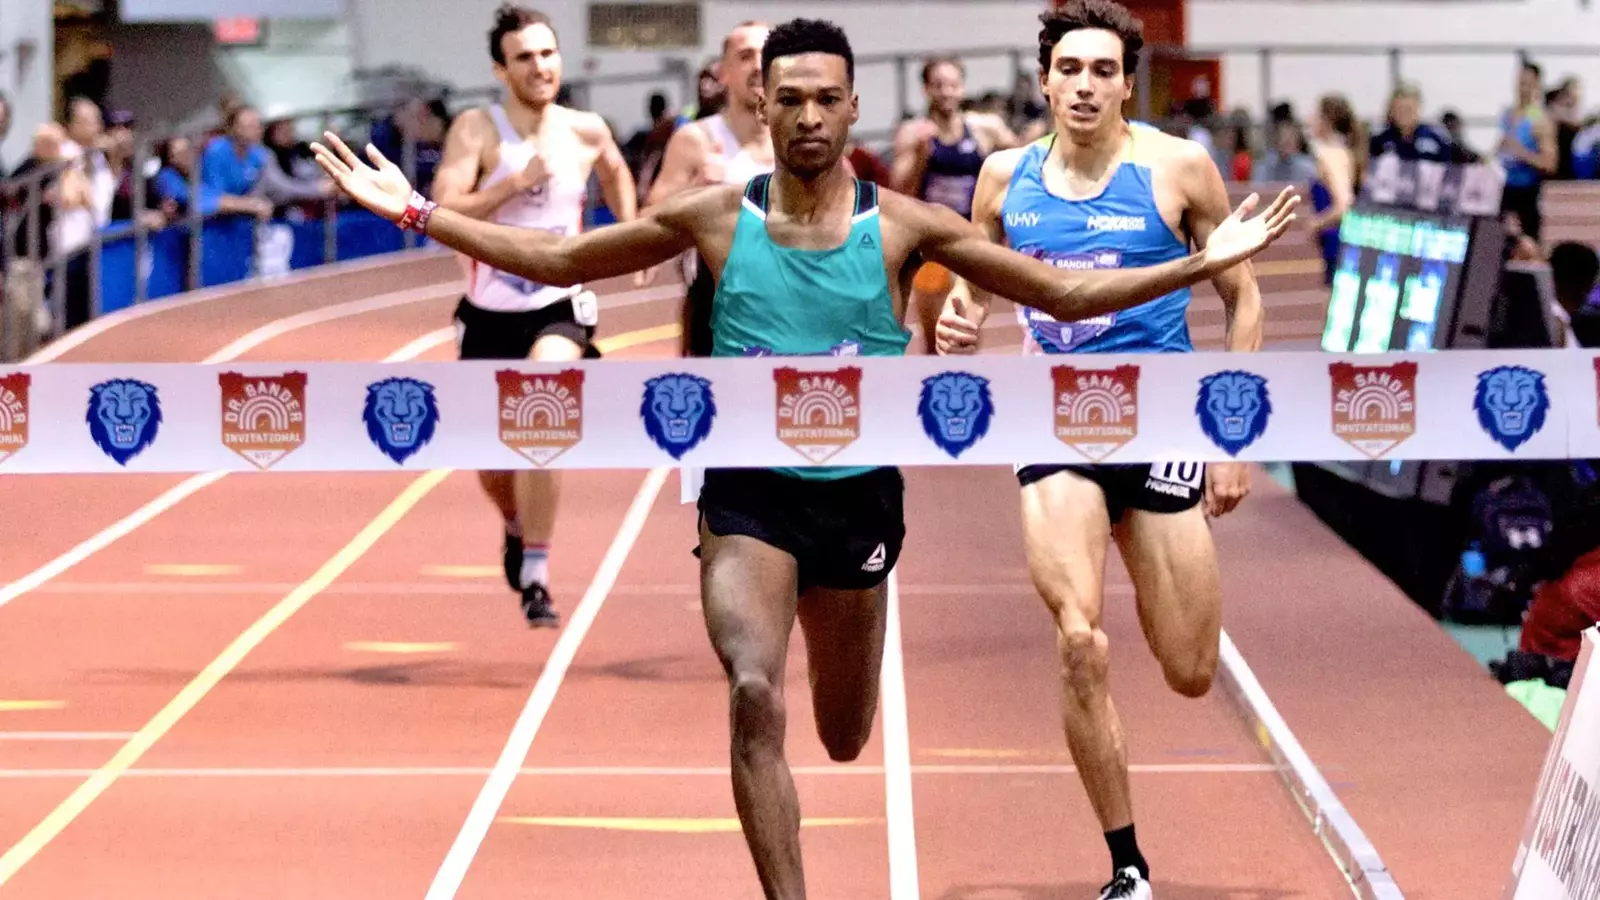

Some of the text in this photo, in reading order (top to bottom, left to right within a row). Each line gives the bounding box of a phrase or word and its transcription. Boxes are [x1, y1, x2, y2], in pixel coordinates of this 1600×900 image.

[245, 381, 302, 422] SANDER
[521, 377, 579, 419] SANDER
[799, 376, 857, 417] SANDER
[1077, 374, 1135, 416] SANDER
[1354, 371, 1412, 412] SANDER
[224, 433, 301, 443] INVITATIONAL
[502, 430, 579, 440] INVITATIONAL
[780, 428, 856, 438] INVITATIONAL
[1057, 427, 1133, 436] INVITATIONAL
